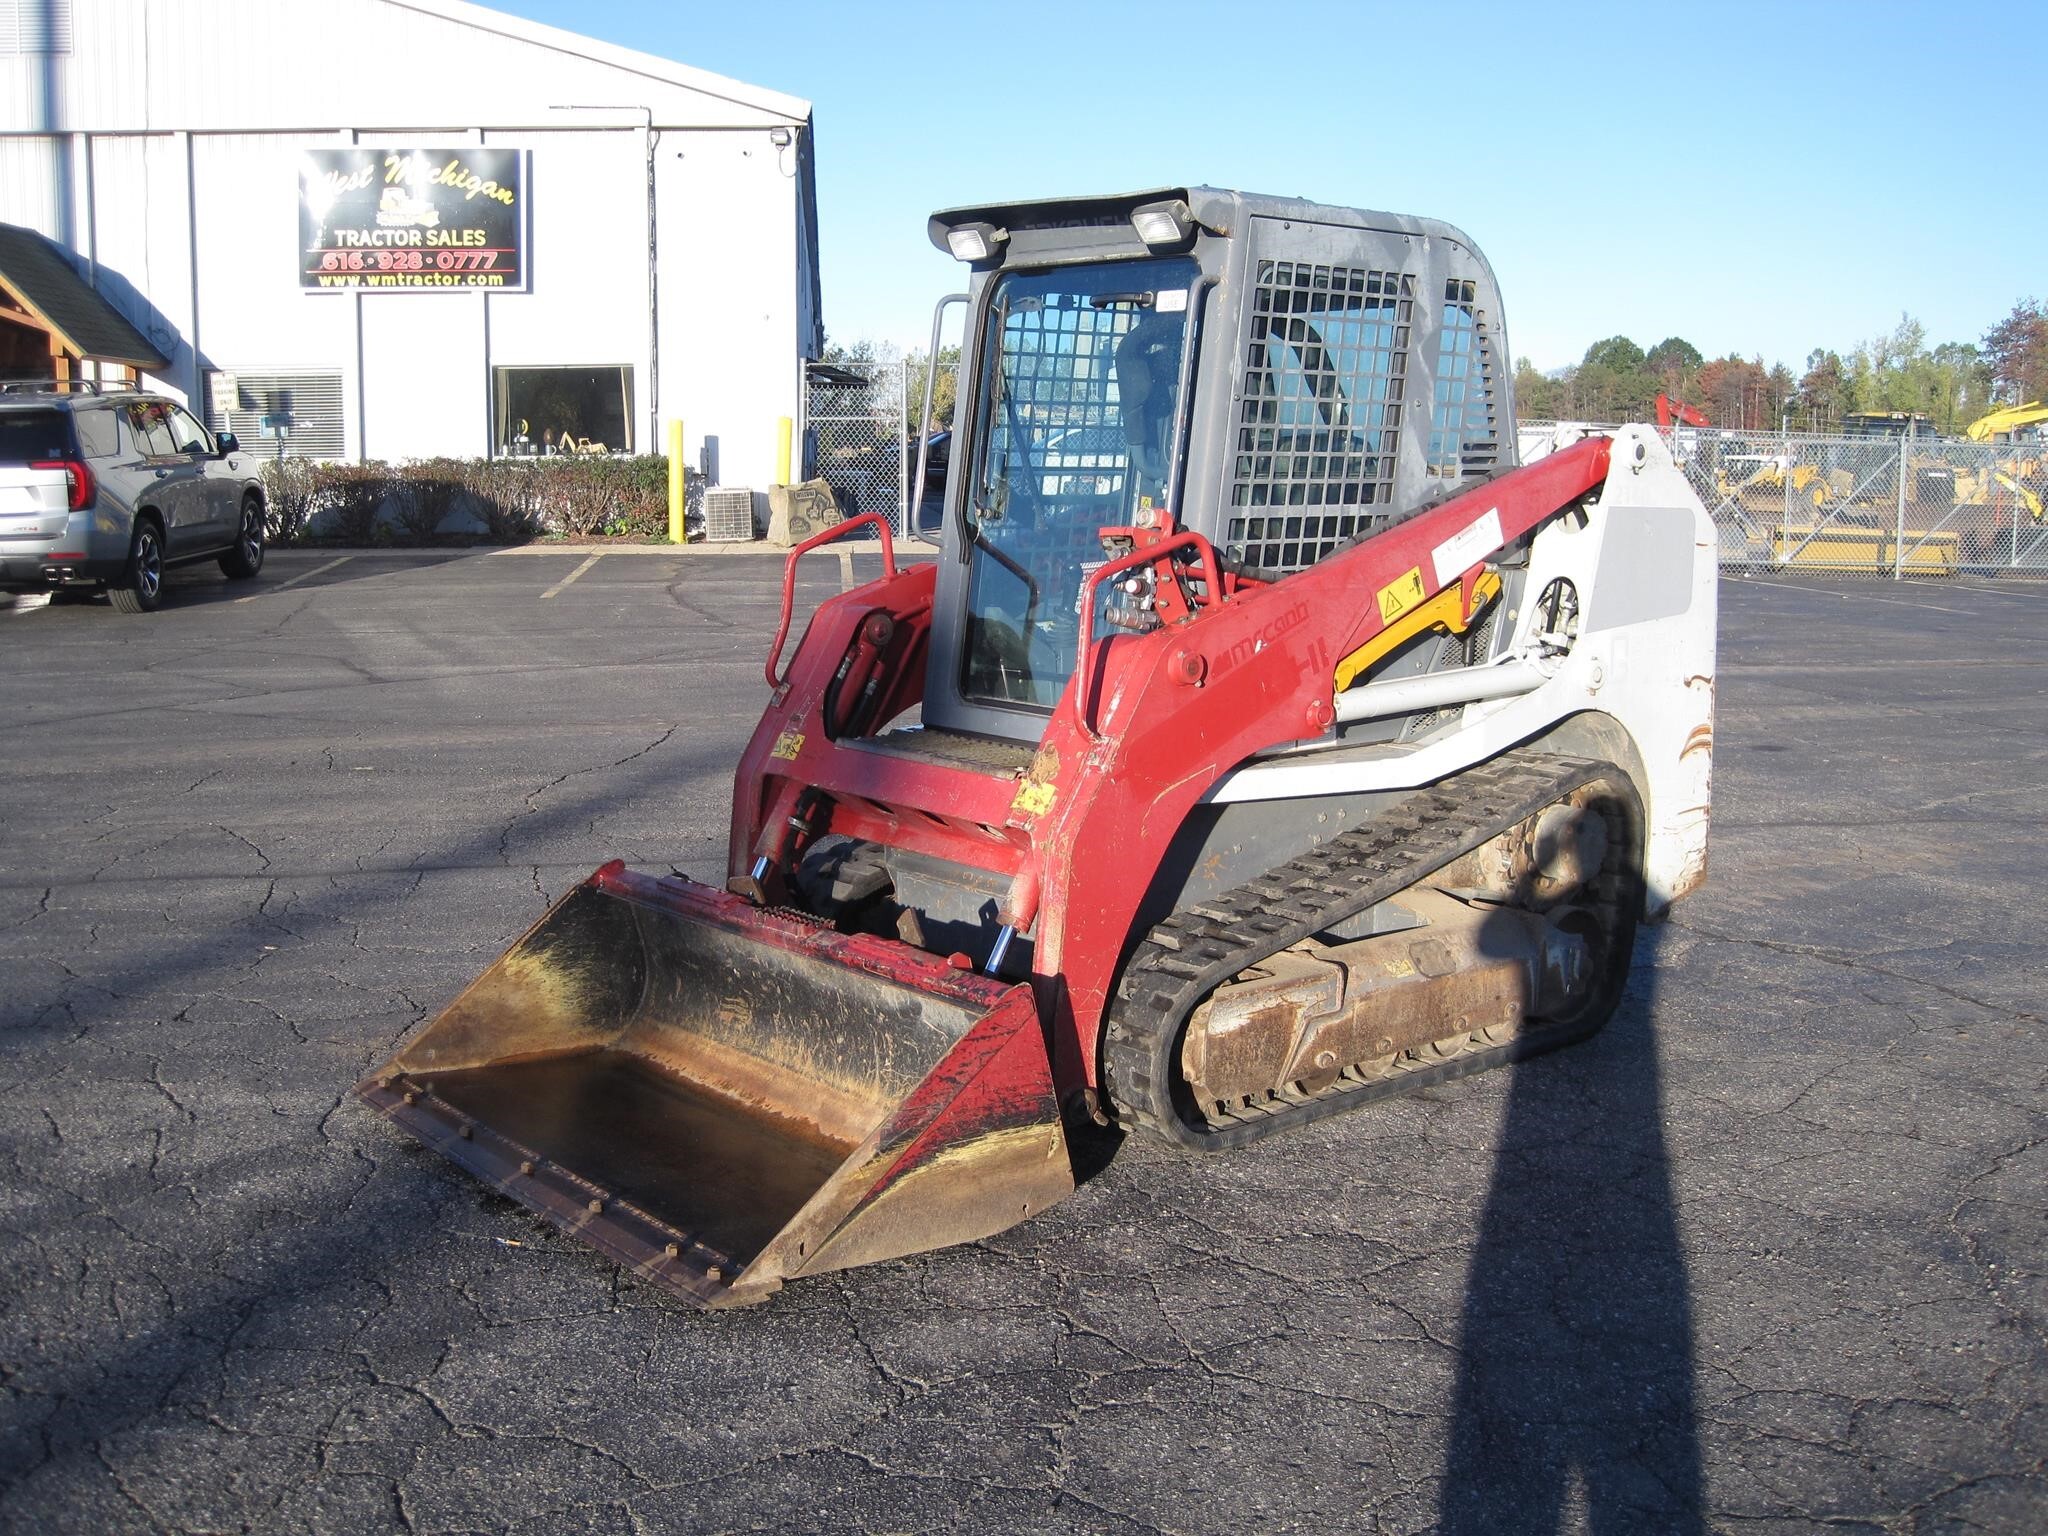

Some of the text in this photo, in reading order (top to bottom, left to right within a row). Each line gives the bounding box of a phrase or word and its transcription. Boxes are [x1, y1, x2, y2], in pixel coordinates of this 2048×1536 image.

[384, 155, 514, 205] Mchigan
[334, 230, 486, 248] TRACTOR SALES
[318, 273, 504, 287] www.wmtractor.com
